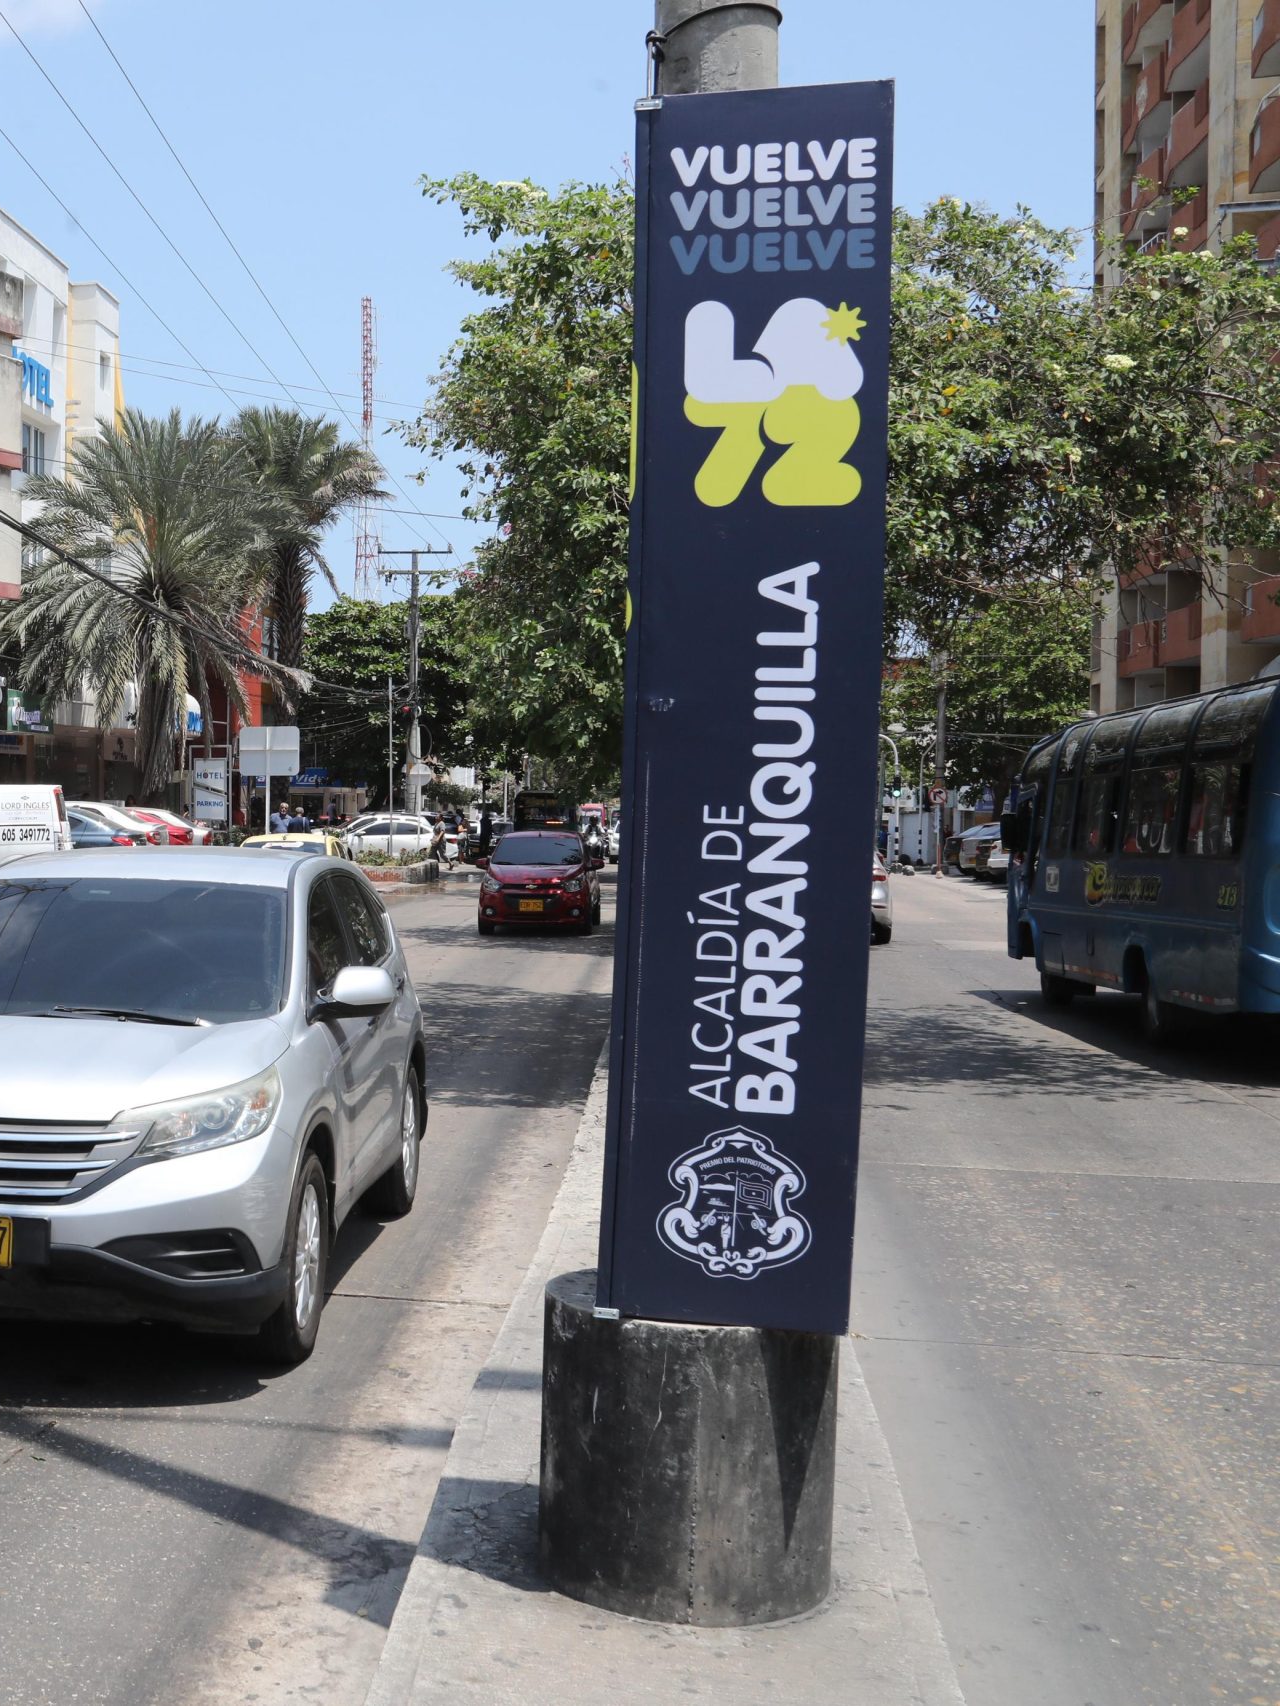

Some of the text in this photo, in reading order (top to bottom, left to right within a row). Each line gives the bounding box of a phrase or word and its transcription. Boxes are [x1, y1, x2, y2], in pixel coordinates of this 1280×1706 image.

[670, 137, 877, 187] VUELVE
[670, 182, 877, 231] VUELVE
[669, 228, 876, 275] VUELVE
[684, 297, 864, 404] LA
[12, 346, 55, 409] OTEL
[683, 384, 862, 508] 72
[196, 770, 224, 780] HOTEL
[0, 801, 50, 810] LORD INGLES
[196, 800, 224, 808] PARKING
[1, 828, 51, 842] 605 3491772
[733, 560, 821, 1116] BARRANQUILLA
[688, 804, 745, 1109] ALCALDÍA DE
[699, 1156, 777, 1176] PREMIO DEL PATRIOTISMO
